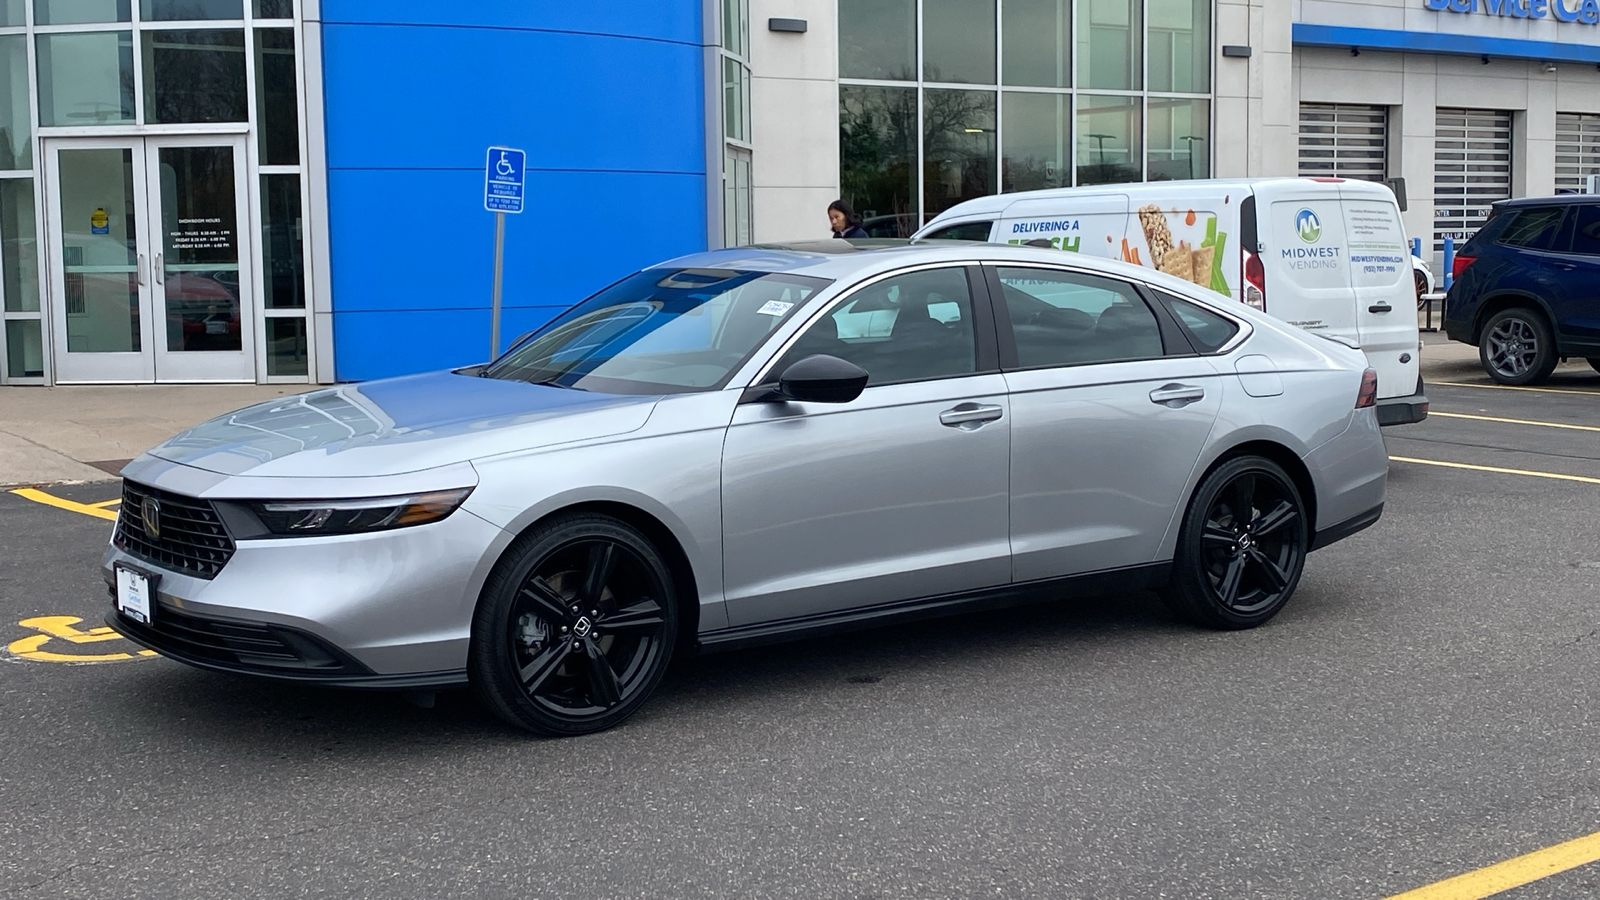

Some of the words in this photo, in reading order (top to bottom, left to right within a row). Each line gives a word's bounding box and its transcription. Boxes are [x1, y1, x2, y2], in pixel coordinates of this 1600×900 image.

[1013, 220, 1069, 233] DELIVERING
[1072, 219, 1080, 230] A
[1281, 247, 1340, 258] MIDWEST
[1289, 259, 1337, 269] VENDING
